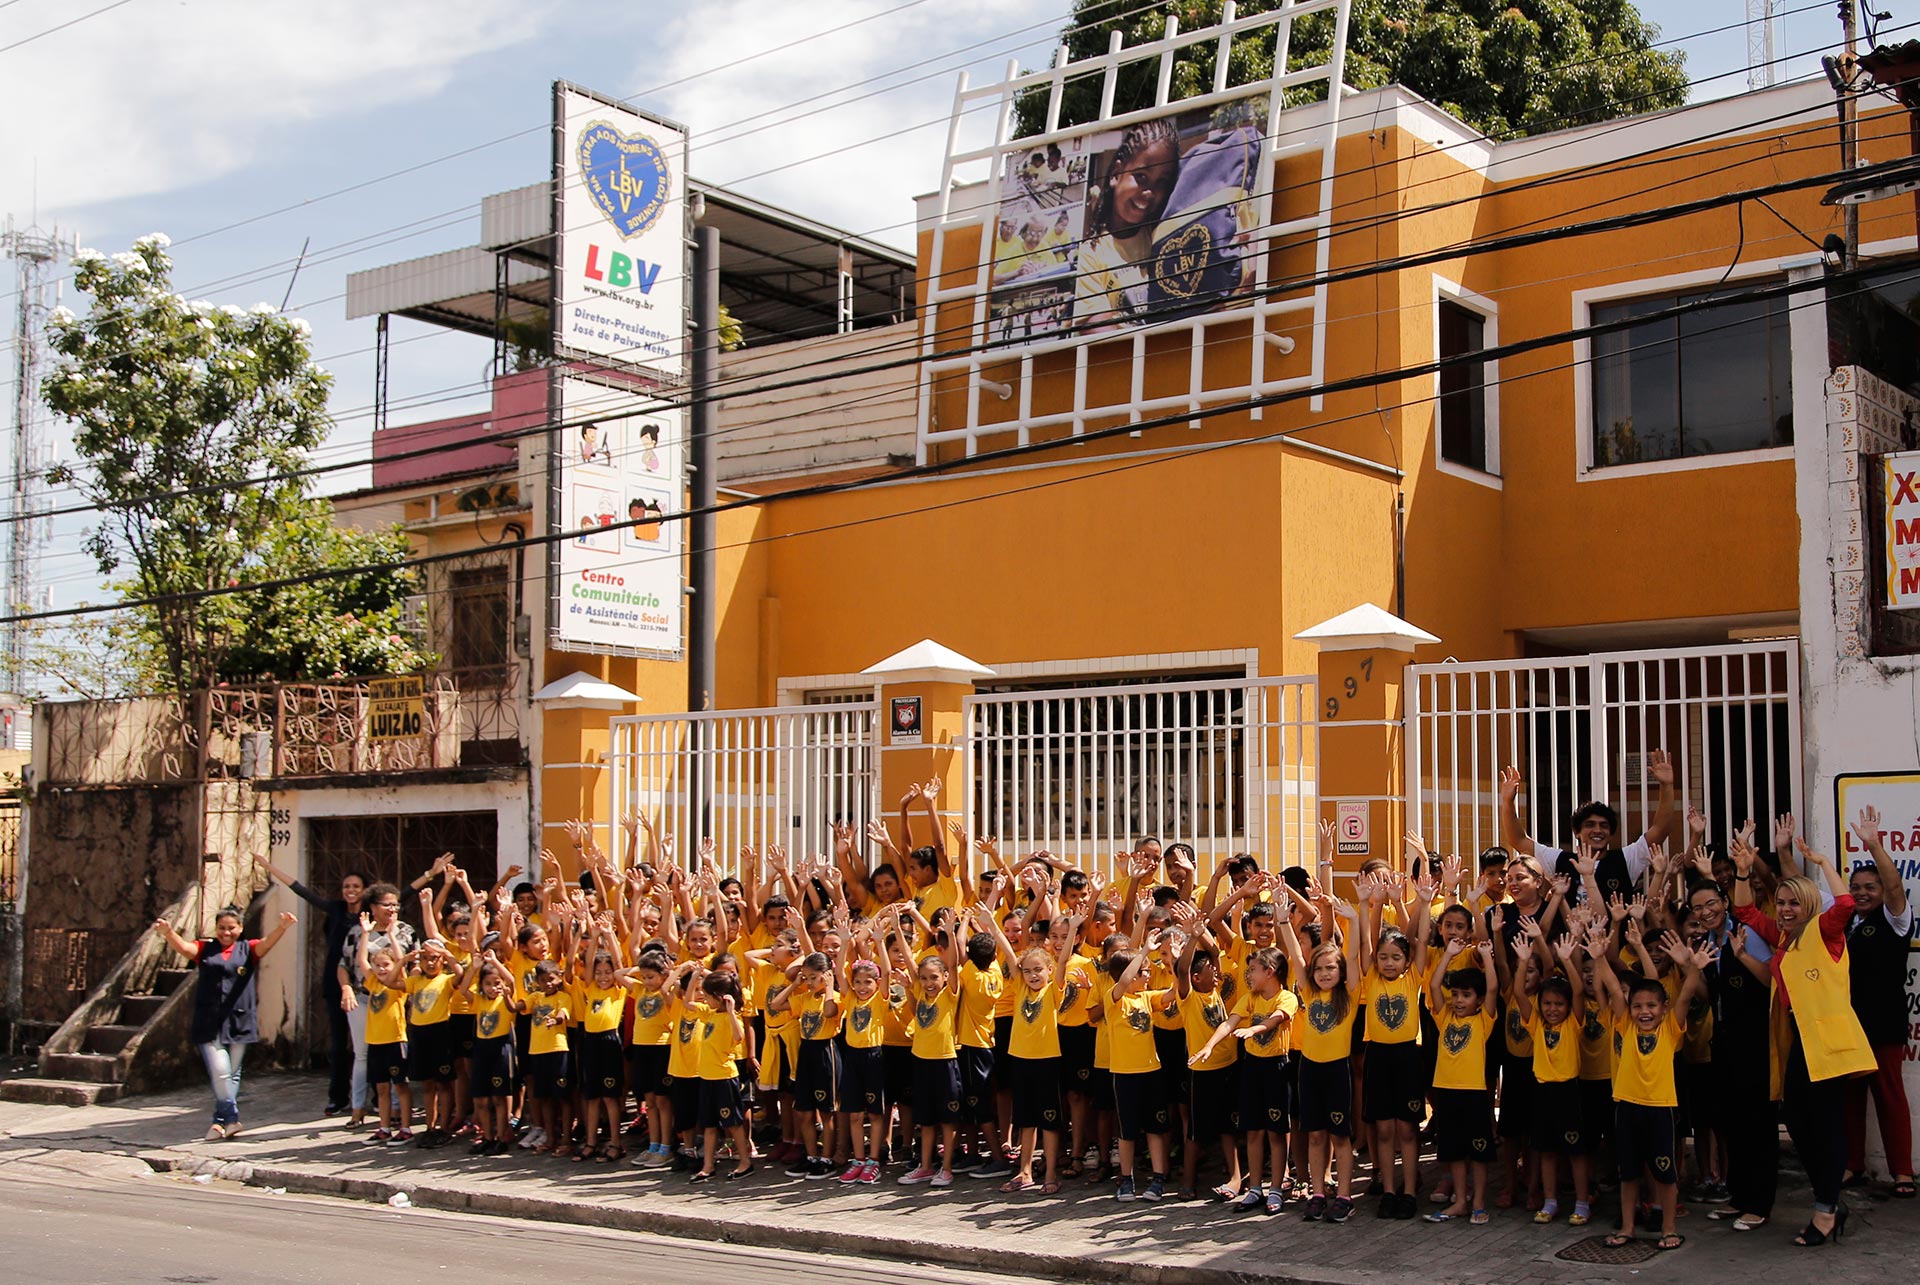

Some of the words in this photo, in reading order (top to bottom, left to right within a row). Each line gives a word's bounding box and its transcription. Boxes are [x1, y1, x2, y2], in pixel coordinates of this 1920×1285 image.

[584, 243, 662, 295] LBV
[573, 323, 595, 337] José
[597, 329, 611, 341] de
[613, 333, 641, 349] Paiva
[581, 568, 625, 586] Centro
[571, 583, 660, 608] Comunitário
[570, 603, 583, 614] de
[585, 605, 639, 621] Assistência
[641, 612, 669, 625] Social
[1339, 843, 1367, 851] GARAGEM
